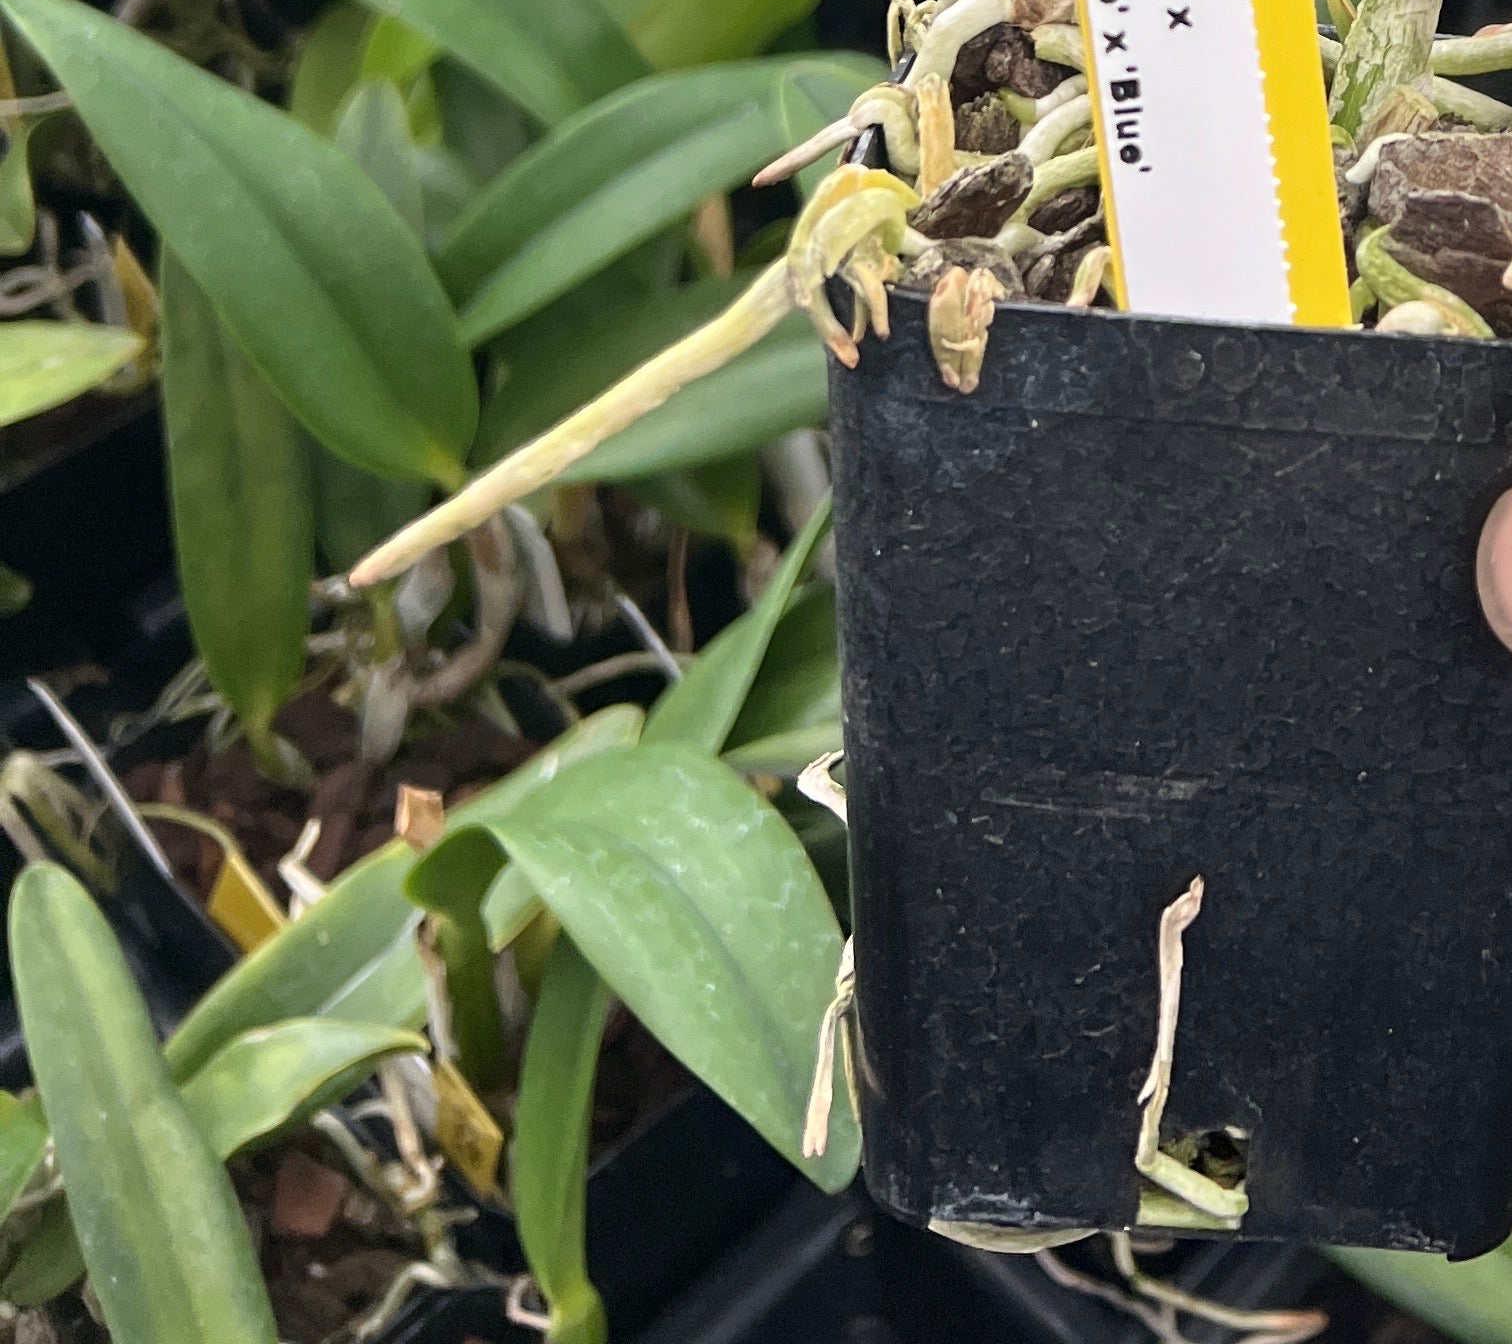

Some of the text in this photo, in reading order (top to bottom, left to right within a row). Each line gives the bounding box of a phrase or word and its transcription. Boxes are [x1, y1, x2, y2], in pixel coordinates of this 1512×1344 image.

[1166, 7, 1193, 30] x
[1103, 31, 1127, 54] x
[1109, 66, 1152, 173] 'Blue'
